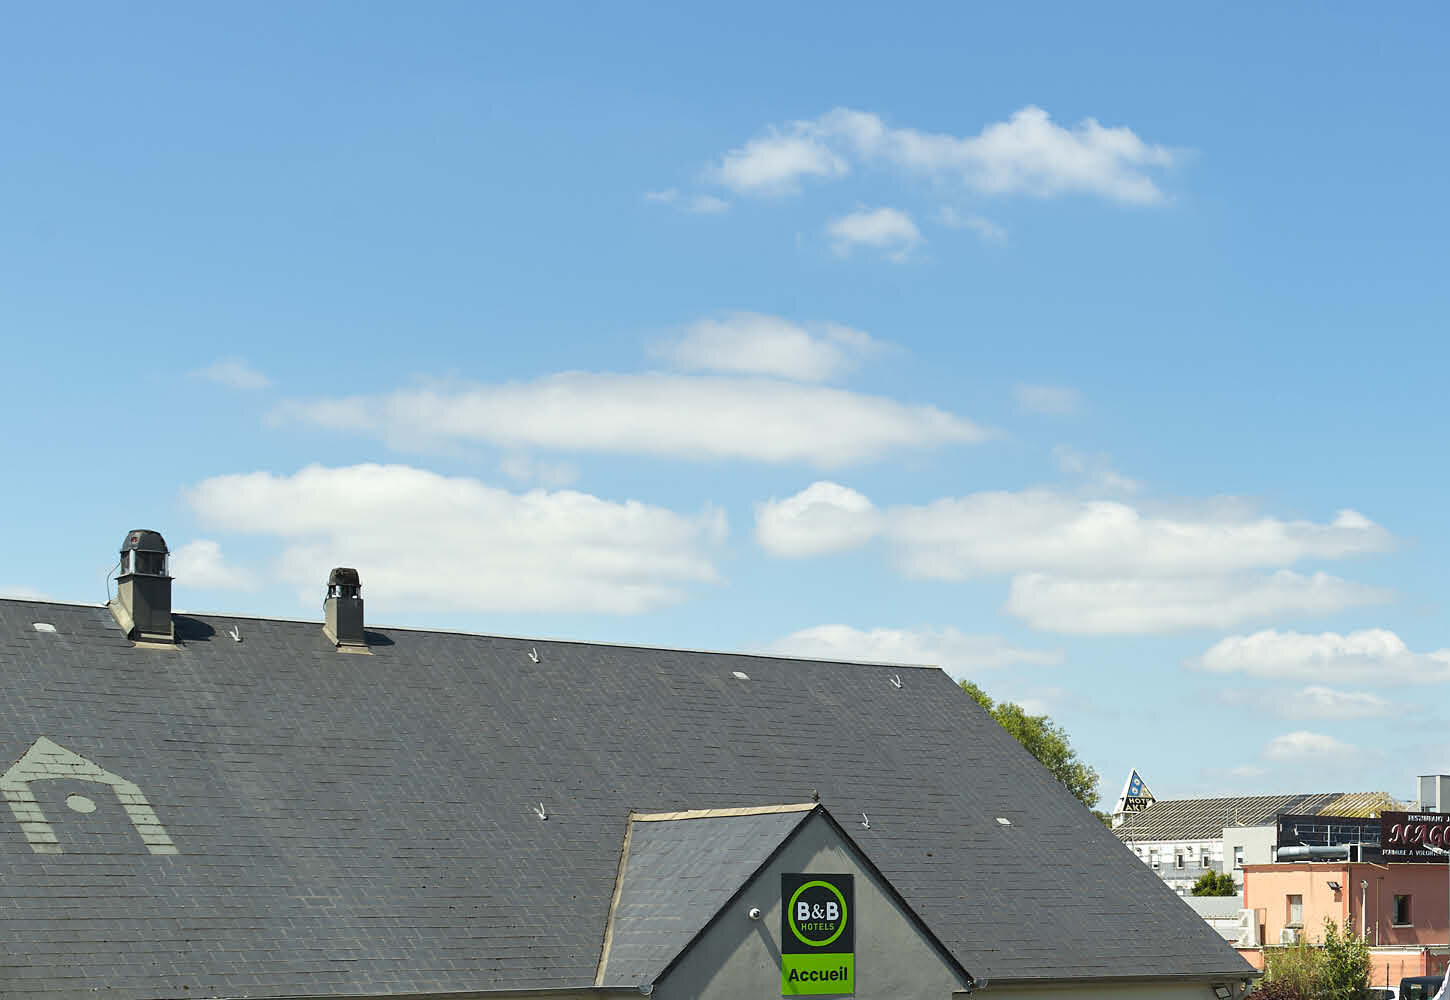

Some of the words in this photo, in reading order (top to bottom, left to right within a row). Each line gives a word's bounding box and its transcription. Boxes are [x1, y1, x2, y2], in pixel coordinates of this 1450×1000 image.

[797, 901, 840, 921] B&B
[801, 922, 835, 931] HOTELS
[788, 966, 848, 982] Accueil
